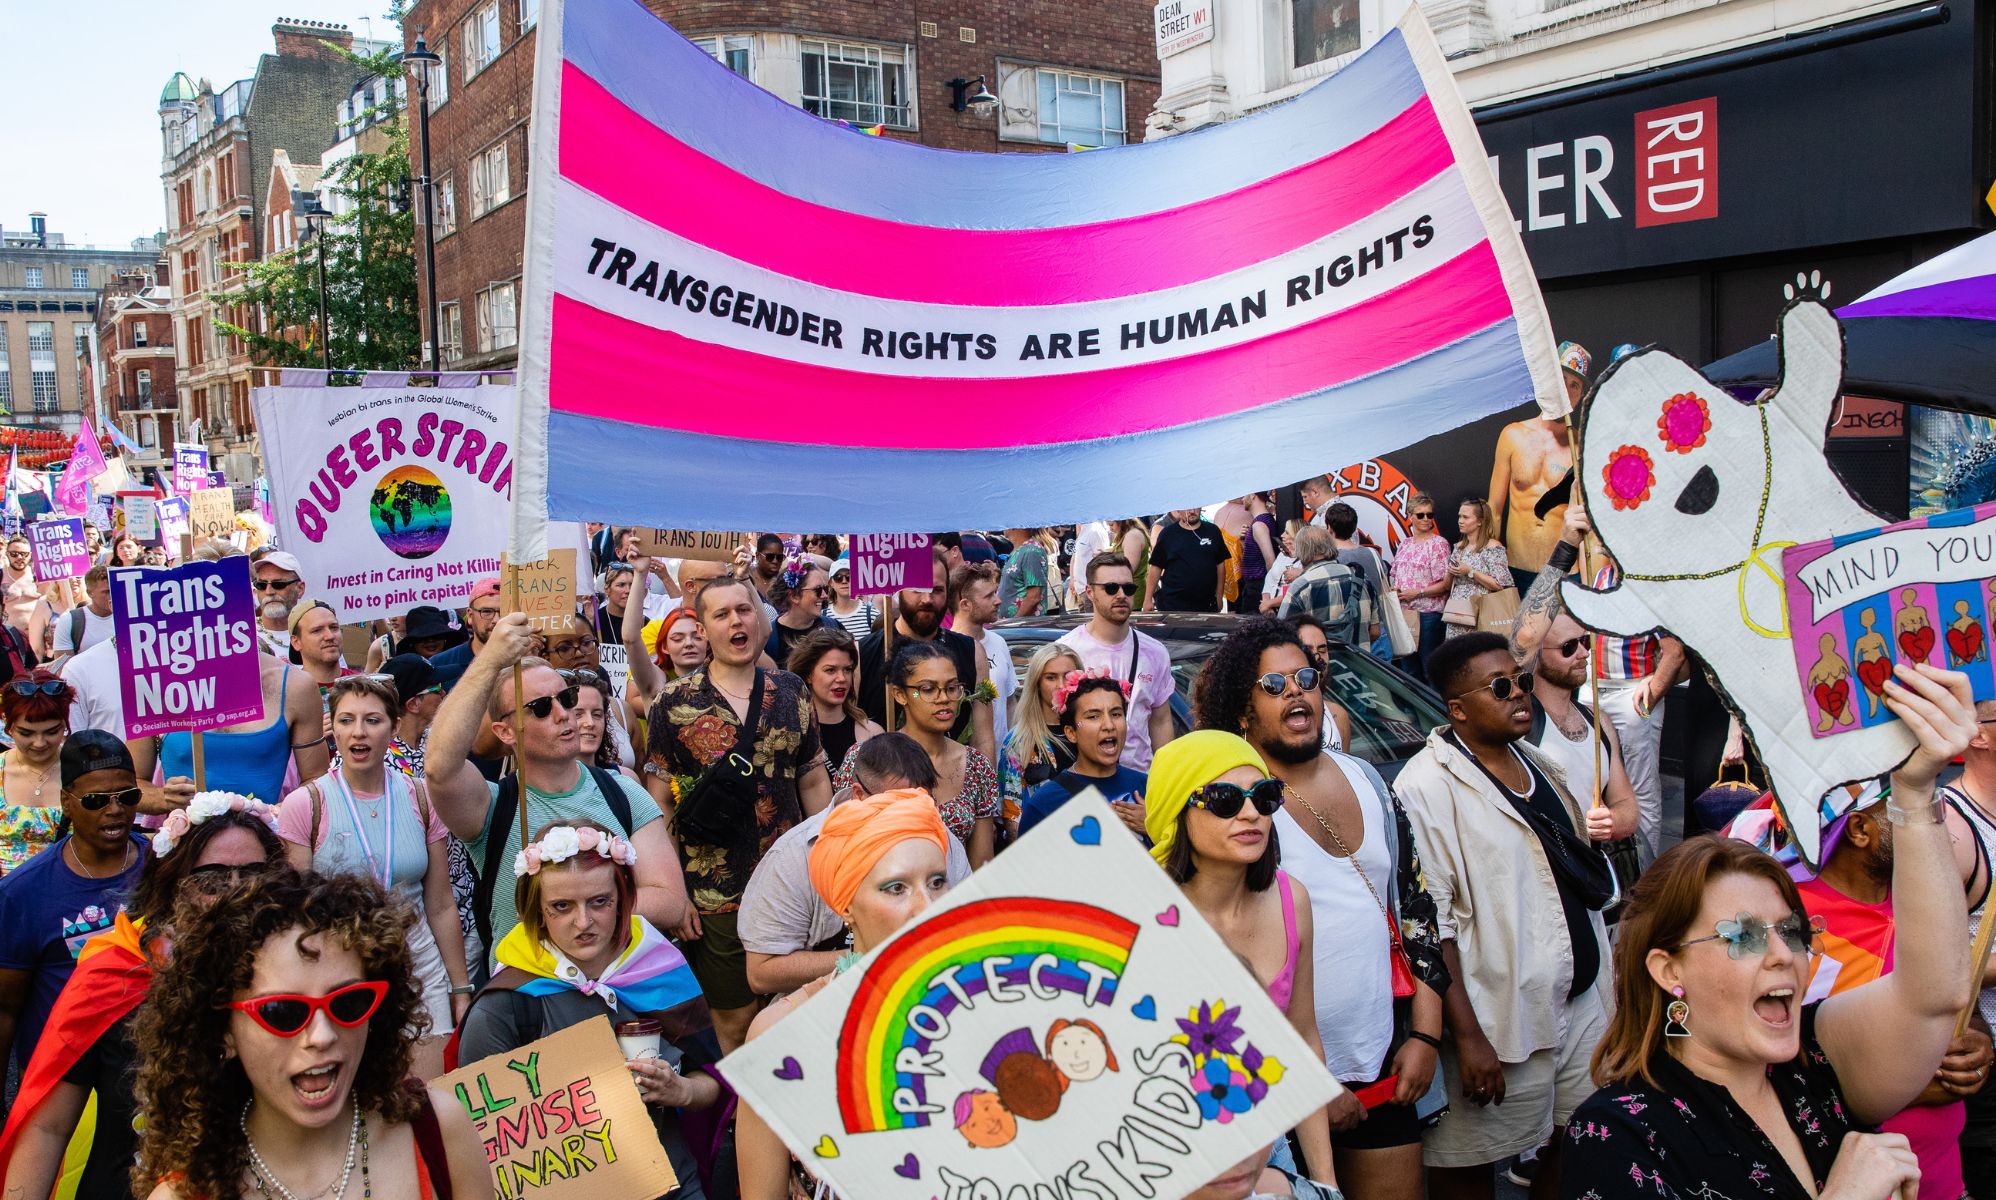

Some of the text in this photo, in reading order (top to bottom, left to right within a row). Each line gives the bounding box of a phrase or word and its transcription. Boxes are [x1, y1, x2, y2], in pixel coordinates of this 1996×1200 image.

[1160, 1, 1182, 23] DEAN
[1160, 8, 1206, 39] STREET W1
[1647, 111, 1704, 213] RED
[586, 213, 1435, 362] TRANSGENDER RIGHTS ARE HUMAN RIGHTS
[327, 394, 498, 427] lesbian bi trans in the Global Women's Strike
[175, 449, 201, 463] Trans
[176, 463, 207, 480] Rights
[176, 477, 198, 491] Now
[295, 417, 406, 543] QUEER
[193, 502, 231, 514] HEALTH
[28, 523, 73, 542] Trans
[195, 519, 234, 536] NOW!
[35, 539, 86, 563] Rights
[39, 561, 73, 580] Now
[327, 573, 367, 590] Invest
[370, 570, 383, 584] in
[387, 565, 433, 583] Caring
[437, 561, 464, 577] Not
[857, 555, 905, 590] Now
[1813, 534, 1992, 604] MIND YOU
[116, 571, 226, 619] Trans
[343, 581, 474, 610] No to pink capitali
[527, 614, 574, 631] TTER
[128, 614, 251, 675] Rights
[134, 672, 217, 718] Now
[142, 717, 214, 732] Socialist Workers Party
[226, 708, 257, 721] swp.org.uk
[893, 953, 1119, 1114] PROTECT
[1097, 1041, 1203, 1199] KIDS
[495, 1119, 618, 1200] INARY
